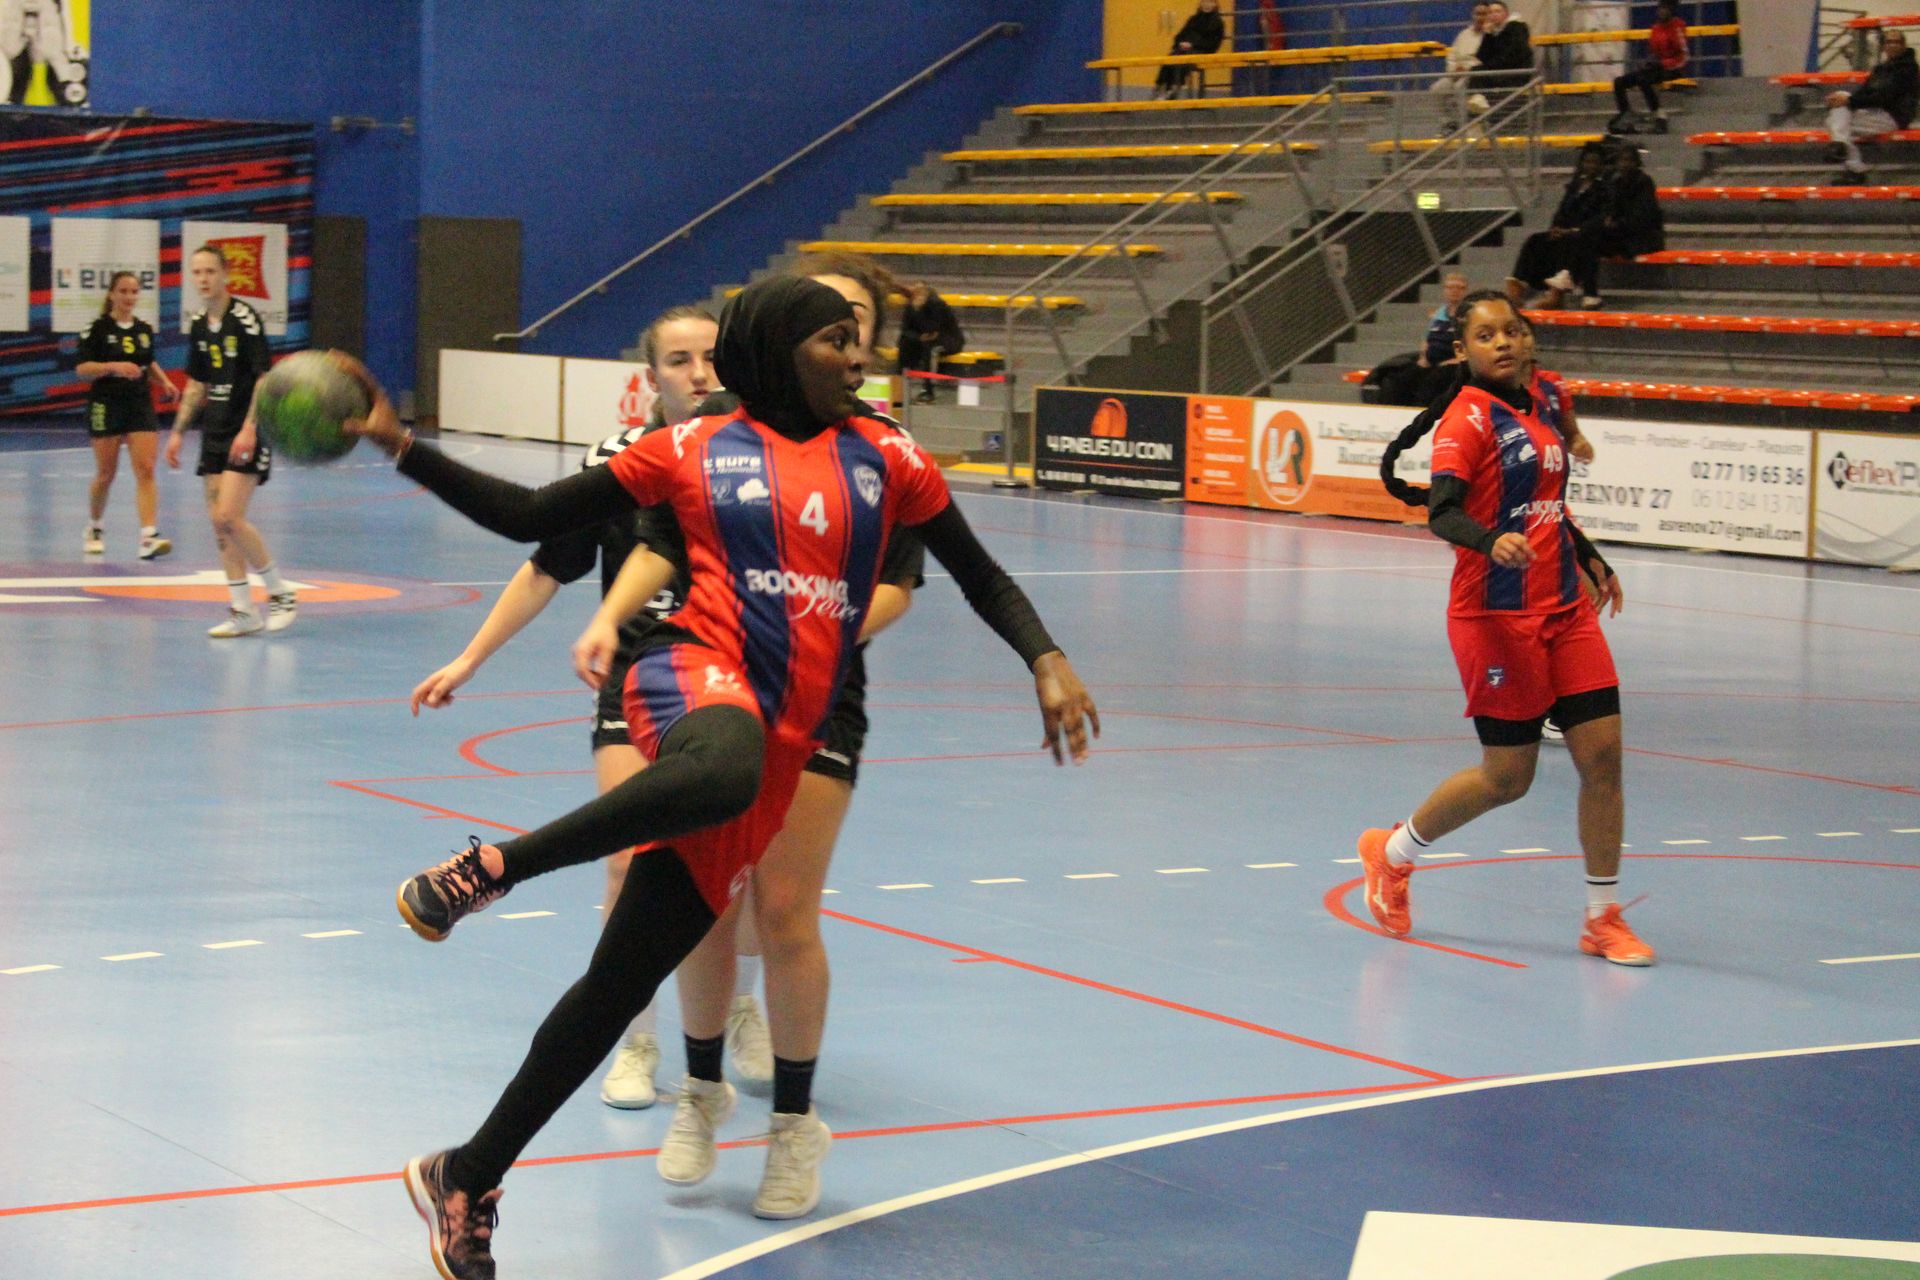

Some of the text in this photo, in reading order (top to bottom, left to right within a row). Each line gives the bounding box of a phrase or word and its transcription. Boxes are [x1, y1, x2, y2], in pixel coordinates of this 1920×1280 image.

[122, 336, 135, 353] 5
[1543, 444, 1563, 473] 49
[1691, 461, 1805, 485] 02 77 19 65 36
[1649, 487, 1673, 509] 27
[1692, 488, 1712, 508] 06
[1715, 489, 1734, 510] 12
[1761, 493, 1781, 513] 13
[1785, 495, 1804, 515] 70
[799, 490, 830, 536] 4
